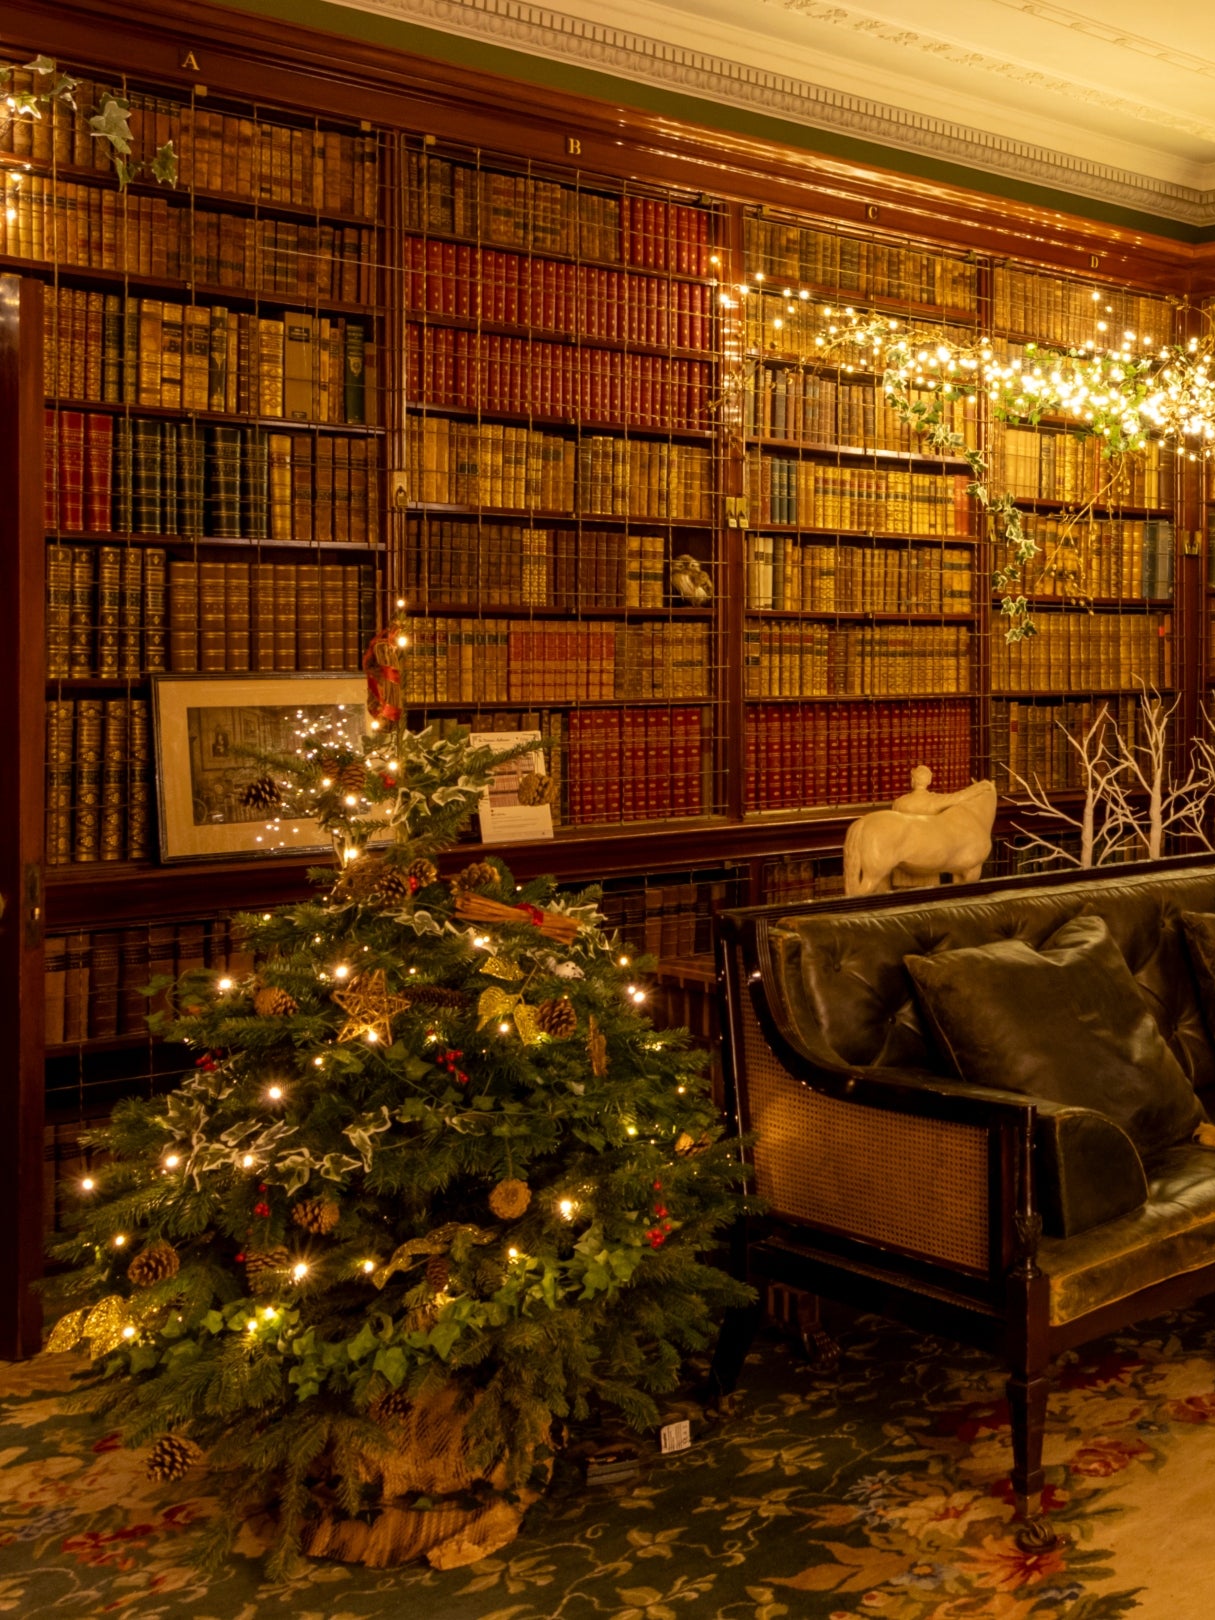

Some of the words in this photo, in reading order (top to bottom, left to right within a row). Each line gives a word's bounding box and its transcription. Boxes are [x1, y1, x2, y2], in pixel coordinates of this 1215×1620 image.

[181, 51, 200, 70] A
[568, 138, 581, 155] B
[868, 206, 878, 219] C
[1091, 256, 1099, 268] D
